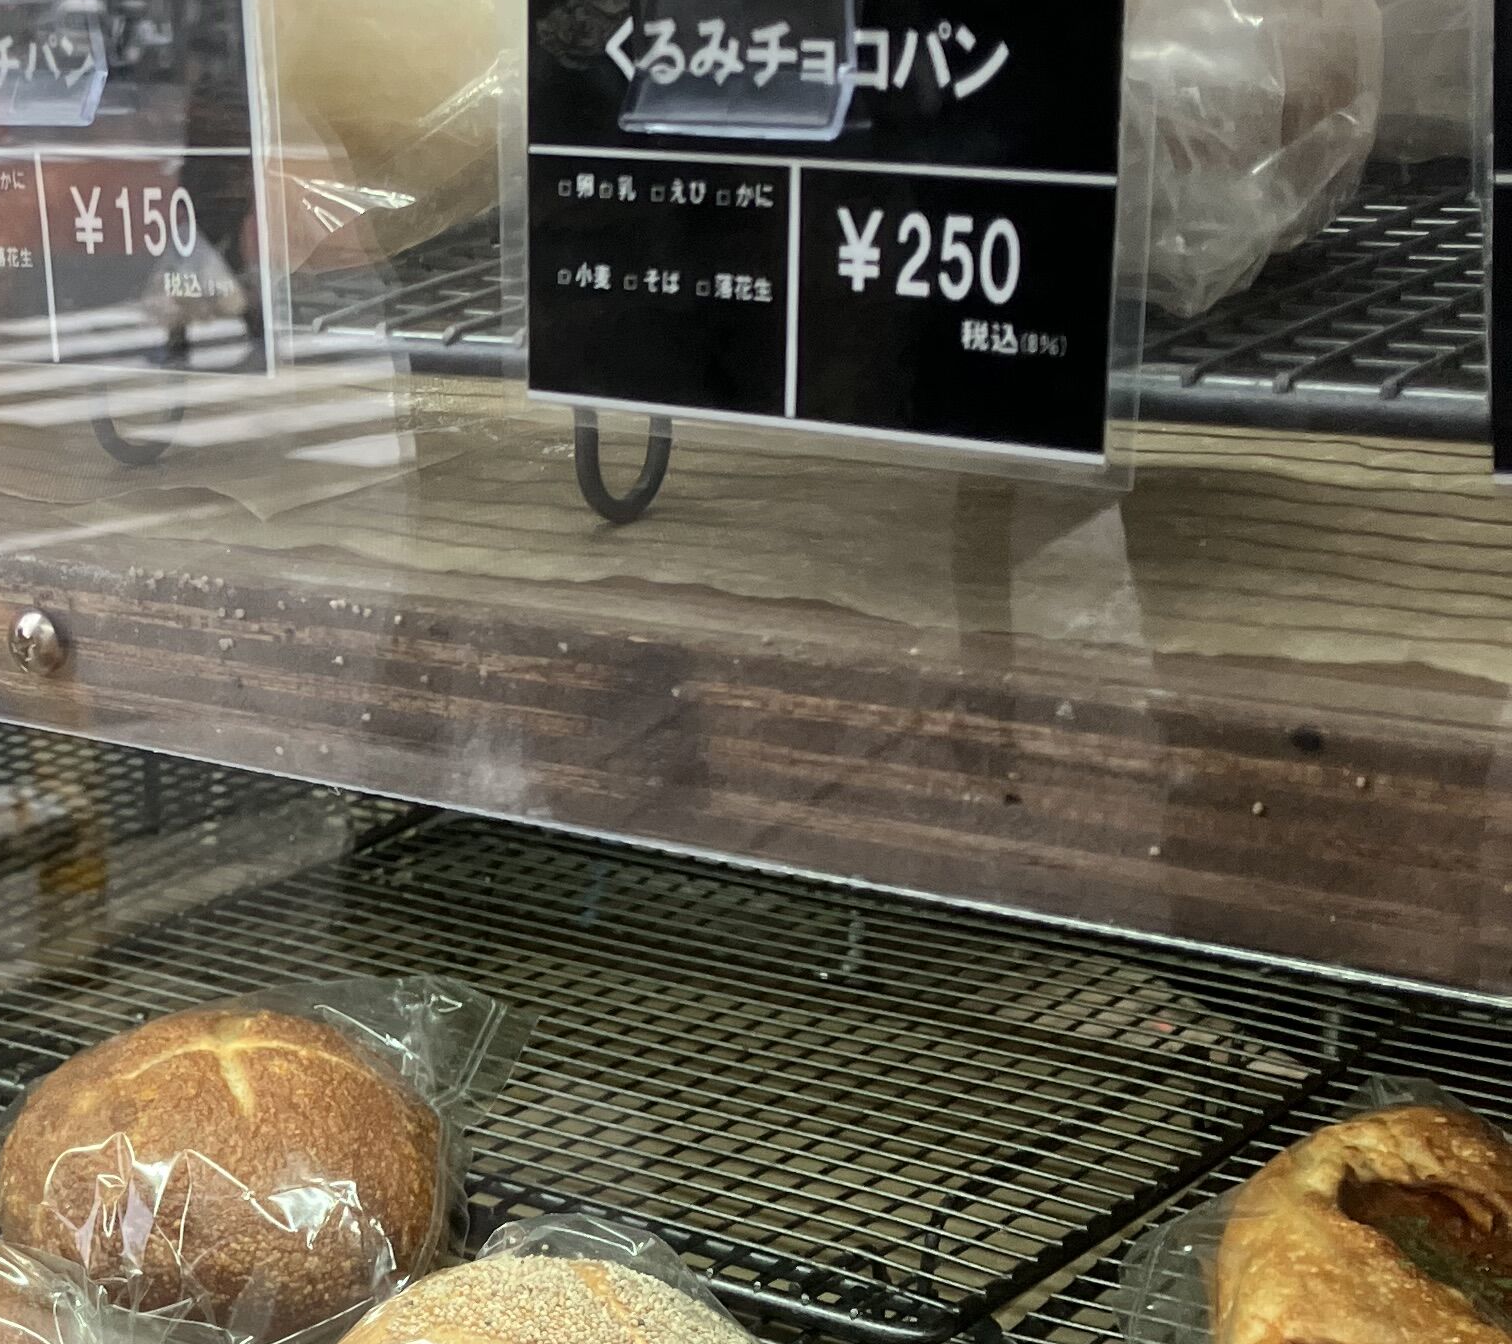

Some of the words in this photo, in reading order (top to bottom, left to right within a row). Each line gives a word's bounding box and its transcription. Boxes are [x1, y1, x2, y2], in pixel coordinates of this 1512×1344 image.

[605, 16, 1010, 99] くるみチョコパン
[70, 186, 196, 256] ¥150
[837, 207, 1021, 304] ¥250
